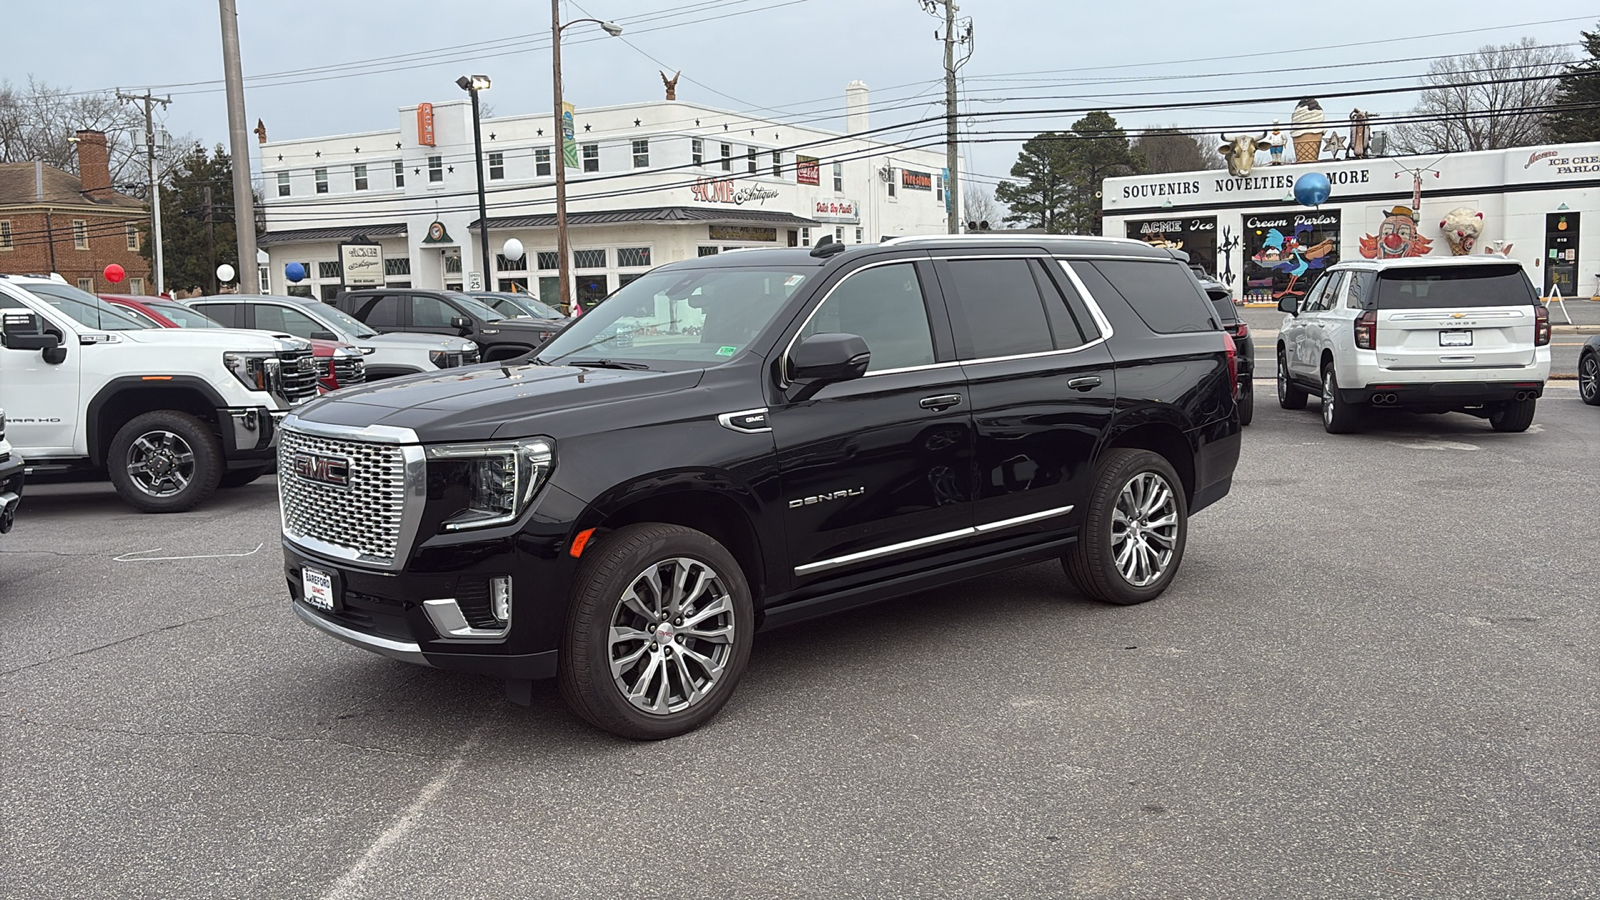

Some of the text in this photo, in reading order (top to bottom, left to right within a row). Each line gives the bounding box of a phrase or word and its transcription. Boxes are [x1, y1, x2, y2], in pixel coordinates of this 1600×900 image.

[1549, 156, 1600, 166] ICE CRE
[902, 170, 931, 187] Firestone
[1123, 170, 1369, 199] SOUVENIRS NOVELTIES MORE
[691, 176, 735, 203] ACME
[745, 182, 779, 205] Antiques
[1140, 219, 1214, 233] ACME Ice
[1247, 215, 1338, 229] Cream Parlor
[471, 281, 480, 289] 25
[745, 415, 765, 423] GMC
[294, 454, 347, 484] GMC
[789, 486, 864, 508] DENALI
[305, 572, 331, 589] BAREFORD
[311, 585, 325, 596] GMC
